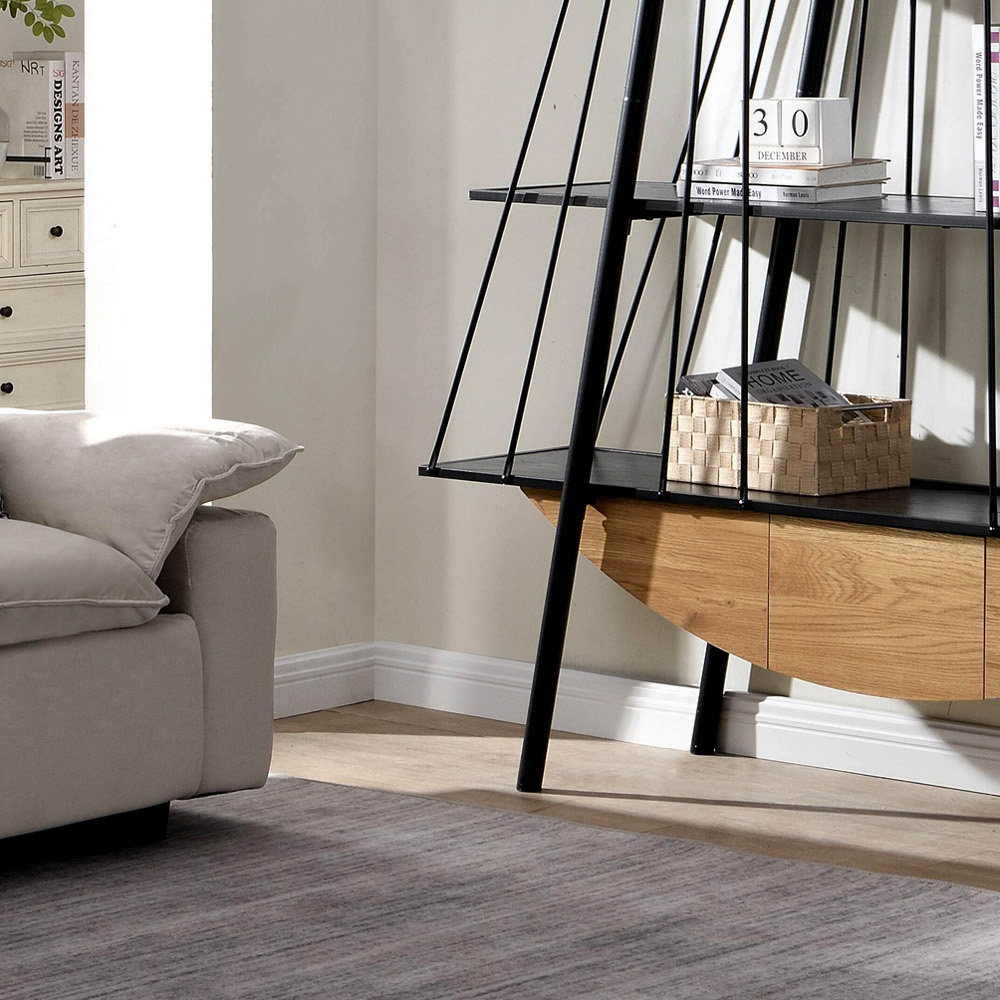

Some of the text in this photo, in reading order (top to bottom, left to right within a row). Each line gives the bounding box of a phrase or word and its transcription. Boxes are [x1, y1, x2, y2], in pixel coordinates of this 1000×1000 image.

[975, 52, 984, 140] Word Power Made Easy
[53, 79, 63, 175] DESIGNS ART
[71, 60, 80, 172] KANTAN DE ZHEXUE
[753, 107, 809, 138] 3 0
[757, 151, 808, 161] DECEMBER
[695, 186, 711, 196] Word
[712, 187, 730, 196] Power
[748, 369, 806, 389] HOME
